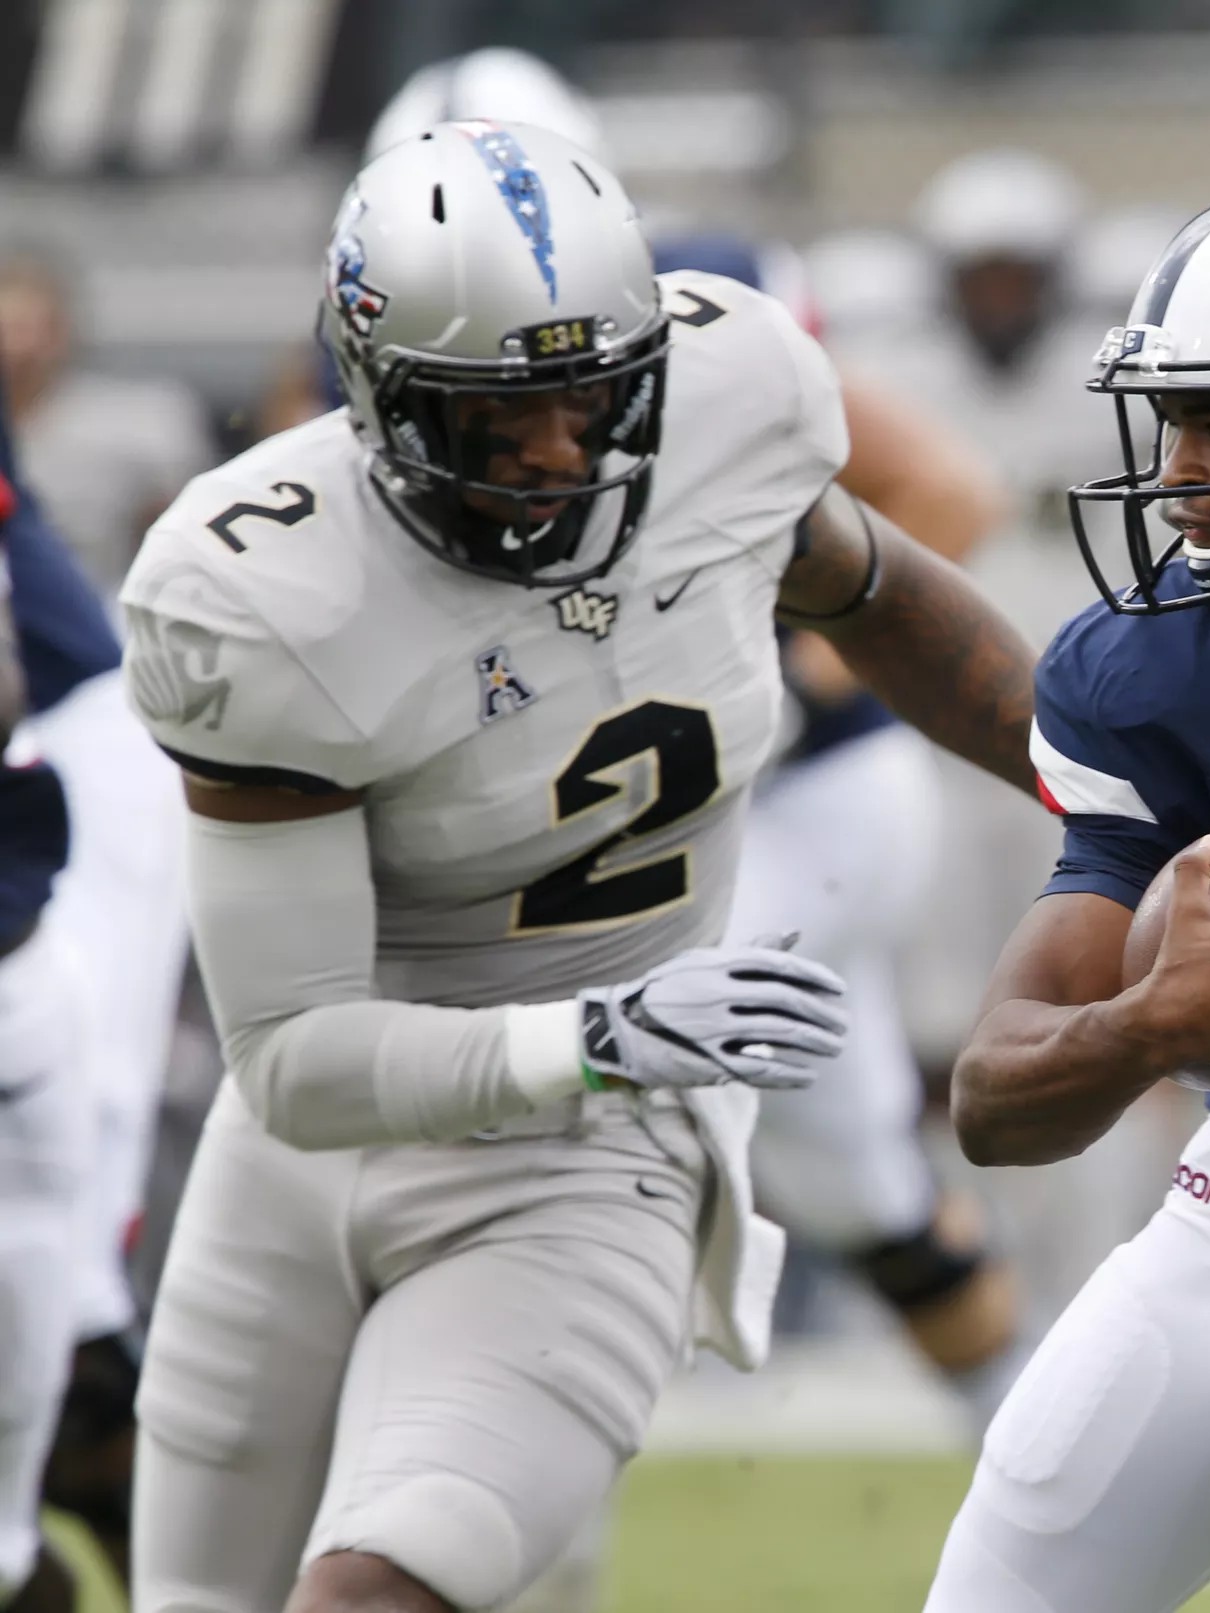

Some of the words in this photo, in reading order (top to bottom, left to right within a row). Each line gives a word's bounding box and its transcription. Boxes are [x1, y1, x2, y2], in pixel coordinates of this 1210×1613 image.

[205, 481, 316, 554] 2
[557, 589, 618, 638] UCF
[507, 695, 722, 938] 2
